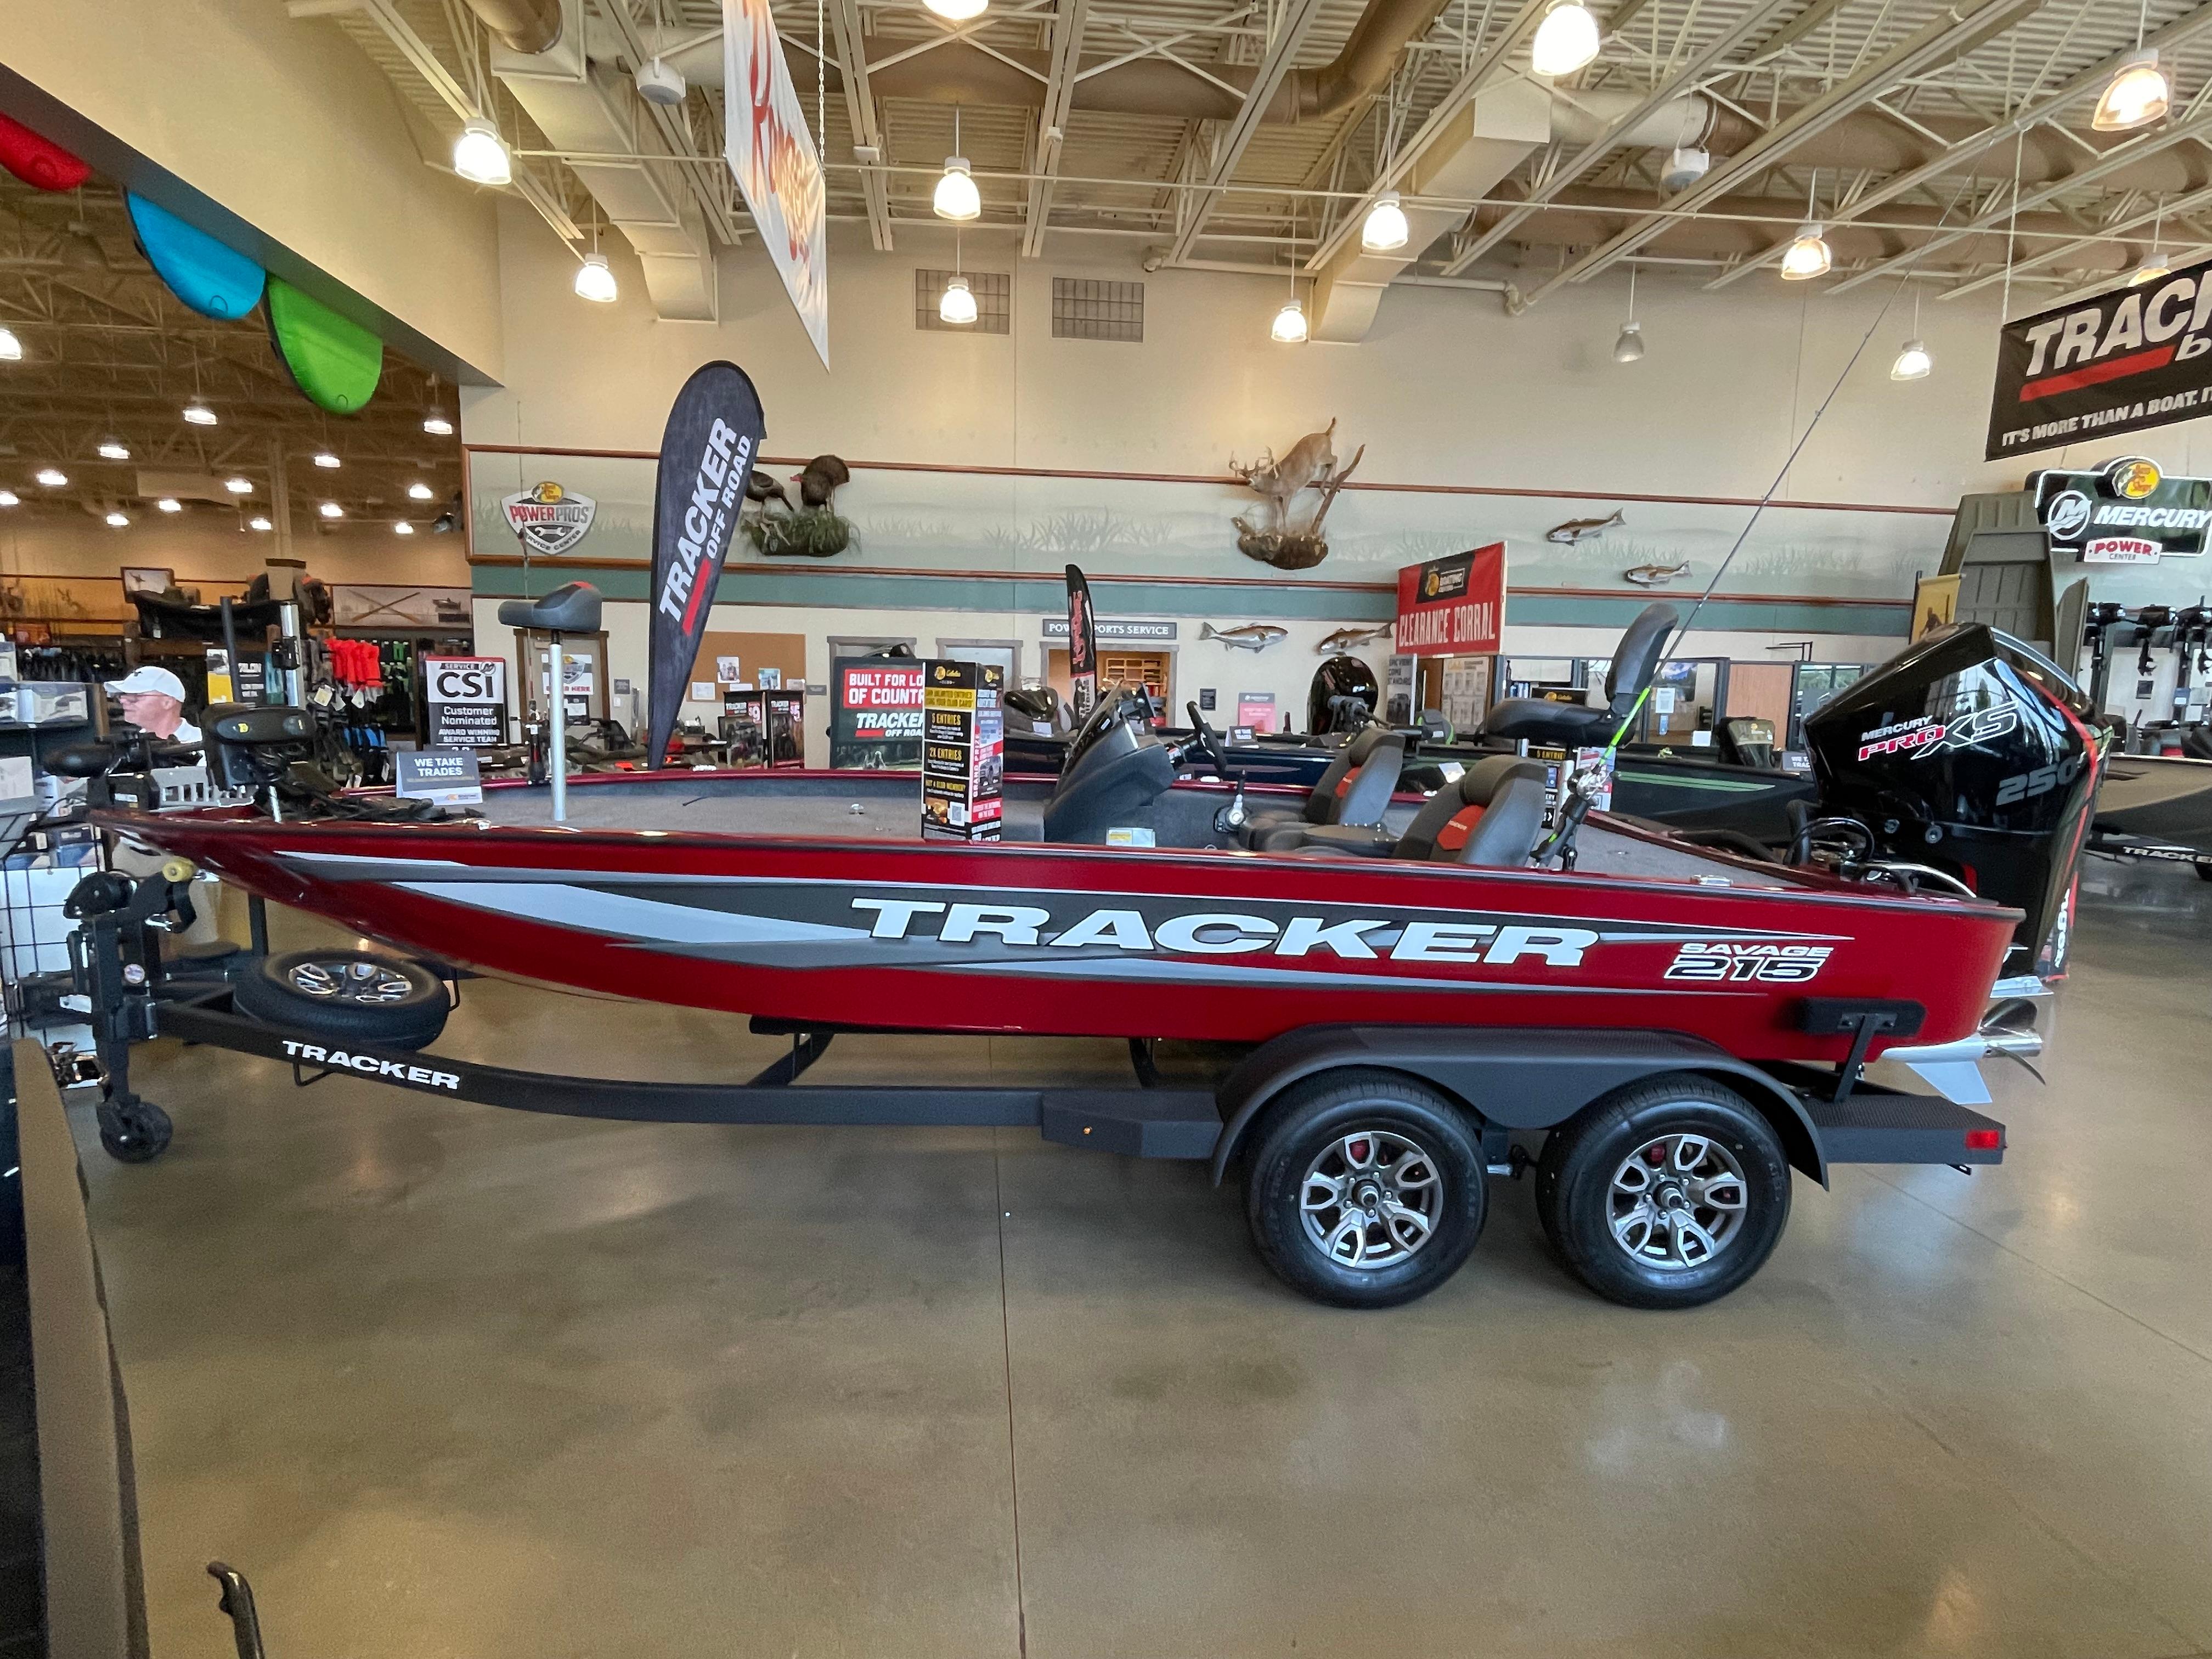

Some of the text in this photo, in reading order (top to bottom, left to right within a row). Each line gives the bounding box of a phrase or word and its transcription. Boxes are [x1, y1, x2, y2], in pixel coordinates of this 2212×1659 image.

[2002, 428, 2030, 447] IT'S
[2032, 416, 2078, 440] MORE
[2081, 405, 2127, 429] THAN
[2129, 403, 2143, 419] A
[2146, 389, 2198, 415] BOAT.
[707, 435, 752, 559] OFF ROAD
[659, 417, 737, 622] TRACKER
[2094, 505, 2212, 528] MERCURY
[2094, 540, 2152, 556] POWER
[2109, 552, 2136, 561] CENTER
[1126, 625, 1169, 635] SERVICE
[1399, 601, 1495, 647] CLEARANCE CORRAL
[849, 673, 923, 687] BUILT FOR LO
[849, 687, 868, 704] OF
[871, 688, 923, 704] COUNTR
[443, 706, 494, 715] Customer
[441, 715, 497, 725] Nominated
[936, 713, 961, 725] ENTRIES
[1861, 715, 1933, 742] MERCURY
[414, 757, 464, 767] WE TAKE
[938, 747, 962, 761] ENTRIES
[417, 766, 463, 777] TRADES
[1996, 755, 2078, 806] 250
[850, 896, 1601, 967] TRACKER
[1680, 942, 1835, 958] SAVAGE
[1663, 953, 1826, 983] 215
[282, 1040, 460, 1090] TRACKER
